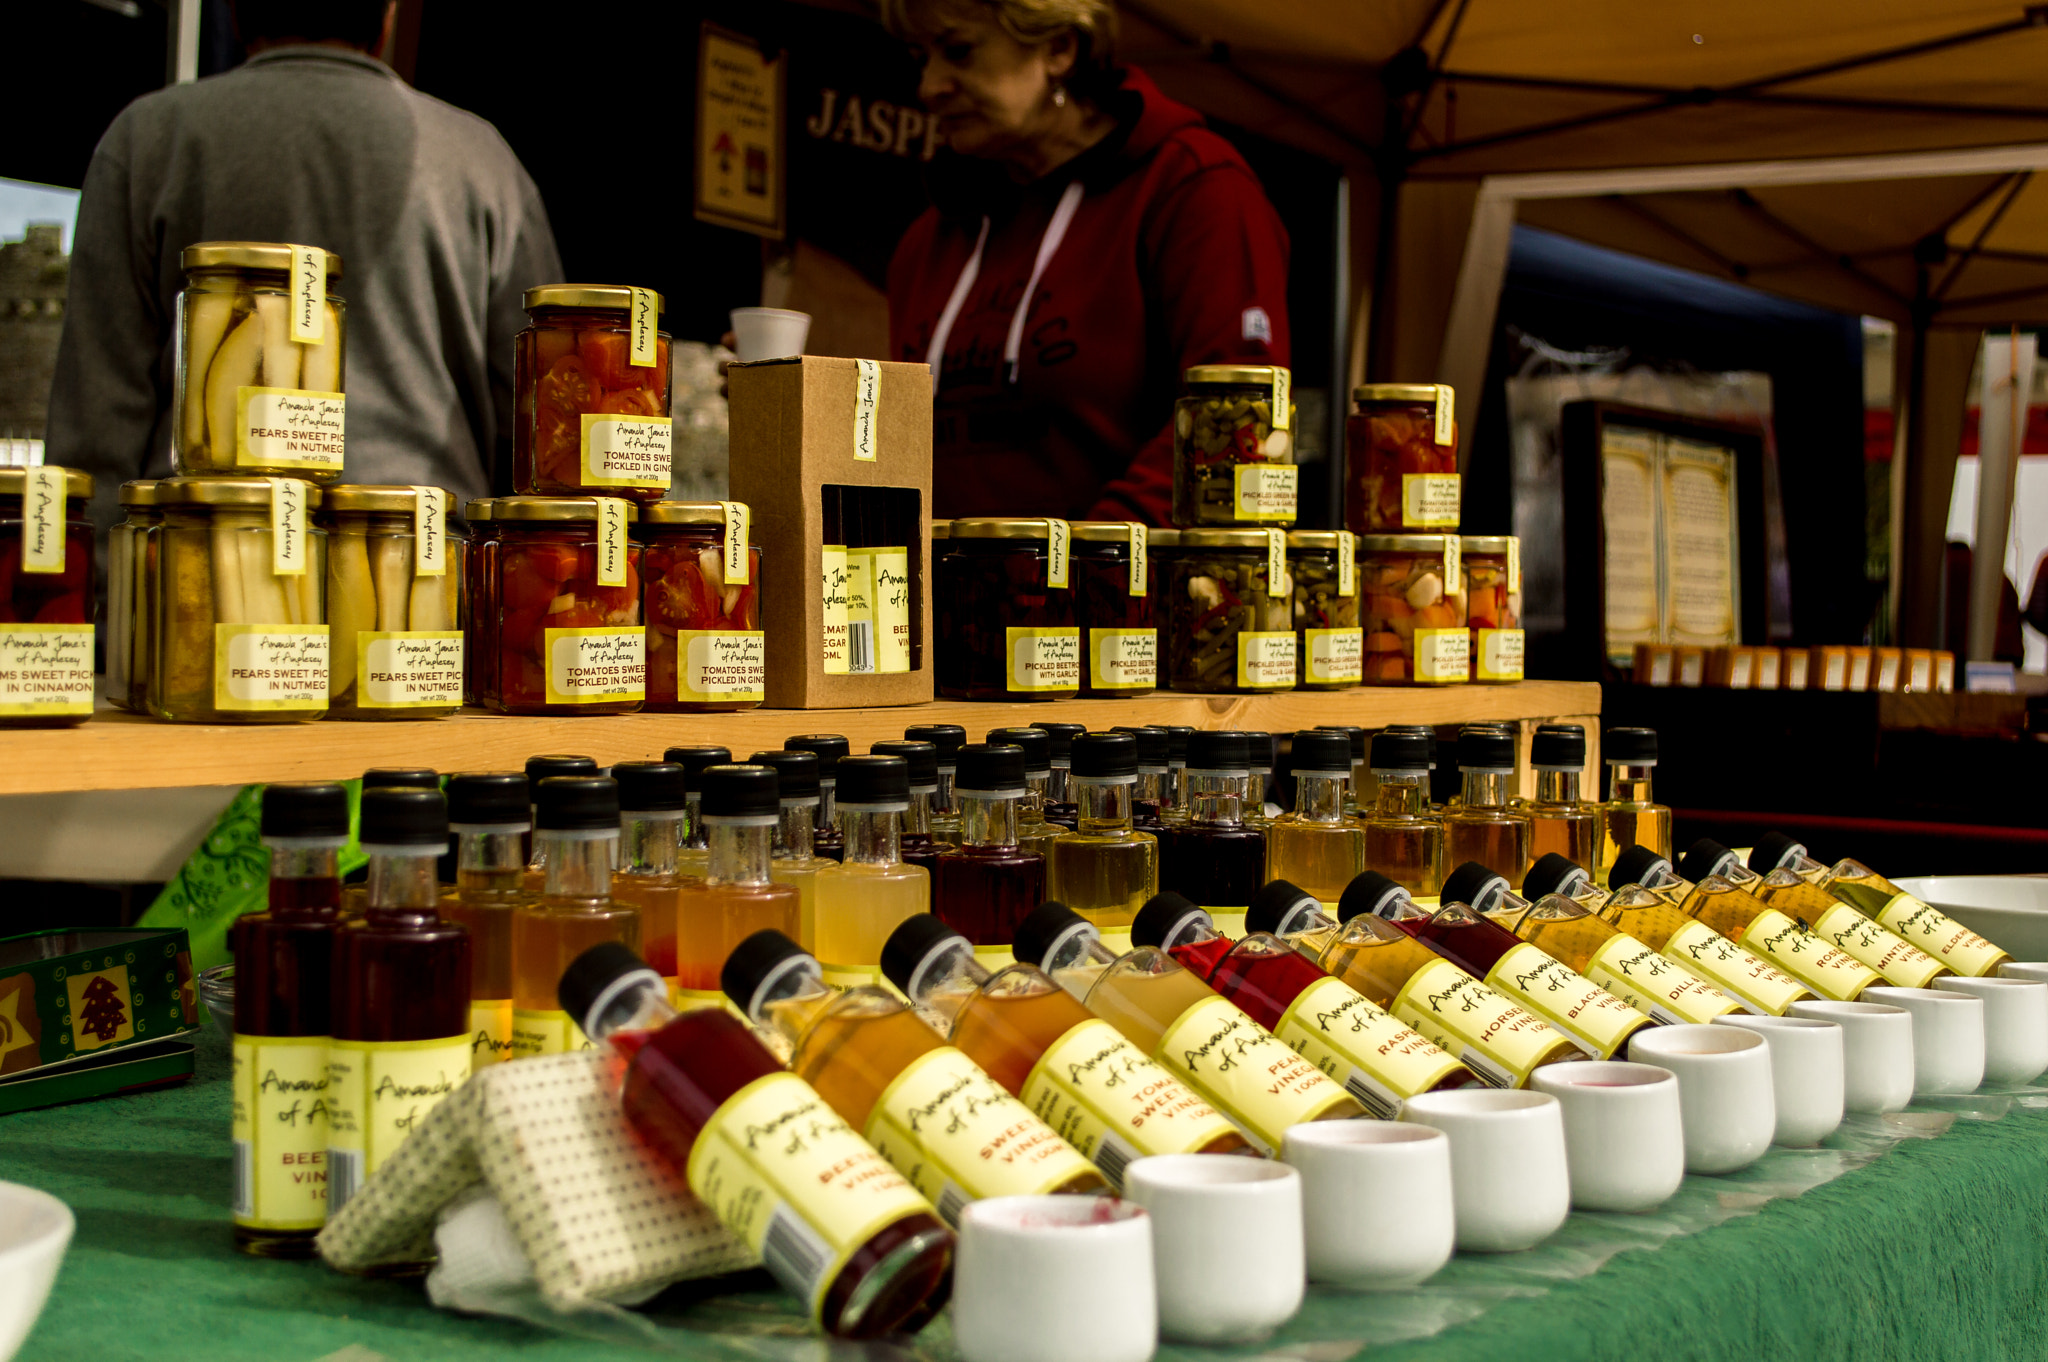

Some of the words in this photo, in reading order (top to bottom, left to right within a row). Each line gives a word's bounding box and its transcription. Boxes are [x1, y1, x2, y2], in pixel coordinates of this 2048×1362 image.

[863, 375, 873, 407] Jane's
[278, 397, 314, 411] Amanda
[319, 401, 344, 415] Jane's
[288, 415, 299, 428] of
[300, 413, 340, 429] Anglesey
[251, 428, 289, 439] PEARS
[291, 430, 327, 441] SWEET
[616, 422, 645, 437] Amanda
[648, 424, 669, 440] Jane's
[859, 412, 869, 453] Amanda
[286, 441, 297, 450] IN
[300, 442, 343, 453] NUTMEG
[624, 439, 633, 449] of
[633, 439, 666, 451] Anglesey
[604, 451, 651, 462] TOMATOES
[603, 462, 641, 471] PICKLED
[642, 463, 652, 471] IN
[890, 589, 901, 608] of
[3, 634, 48, 650] Amanda
[54, 633, 87, 652] Jane's
[260, 635, 296, 650] Amanda
[300, 636, 327, 652] Jane's
[397, 639, 434, 654] Amanda
[435, 640, 460, 656] Jane's
[580, 637, 612, 651] Amanda
[614, 635, 638, 653] Jane's
[714, 637, 739, 650] Amanda
[742, 637, 763, 655] Jane's
[16, 652, 26, 664] of
[32, 652, 80, 667] Anglesey
[270, 651, 281, 664] of
[282, 651, 323, 666] Anglesey
[406, 655, 417, 666] of
[418, 654, 456, 669] Anglesey
[590, 651, 599, 663] of
[599, 650, 634, 664] Anglesey
[721, 653, 730, 662] of
[730, 652, 759, 665] Anglesey
[1043, 651, 1050, 660] of
[1051, 649, 1073, 661] Anglesey
[567, 666, 620, 677] TOMATOES
[702, 666, 746, 675] TOMATOES
[1025, 662, 1055, 670] PICKLED
[1110, 660, 1137, 668] PICKLED
[1138, 668, 1155, 676] GARLIC
[21, 671, 65, 680] SWEET
[232, 669, 271, 679] PEARS
[273, 669, 309, 679] SWEET
[371, 672, 408, 681] PEARS
[410, 672, 443, 681] SWEET
[567, 677, 609, 687] PICKLED
[611, 676, 620, 685] IN
[701, 676, 737, 685] PICKLED
[737, 676, 746, 684] IN
[1039, 670, 1056, 678] WITH
[1056, 670, 1078, 678] GARLIC
[7, 683, 20, 692] IN
[24, 683, 93, 692] CINNAMON
[269, 681, 280, 690] IN
[283, 681, 326, 690] NUTMEG
[406, 683, 416, 692] IN
[419, 682, 460, 691] NUTMEG
[1923, 920, 1937, 935] of
[1791, 935, 1807, 953] of
[1860, 930, 1875, 947] of
[1717, 944, 1733, 961] of
[1649, 960, 1664, 976] of
[1548, 973, 1565, 992] of
[1669, 980, 1694, 1001] DILL
[1461, 993, 1480, 1013] of
[1351, 1009, 1370, 1032] of
[1184, 1017, 1240, 1071] Amanda
[1218, 1047, 1239, 1072] of
[1105, 1063, 1126, 1087] of
[908, 1071, 972, 1132] Amanda
[1131, 1086, 1182, 1129] SWEET
[278, 1100, 303, 1127] of
[395, 1105, 418, 1132] of
[946, 1107, 968, 1134] of
[785, 1128, 809, 1155] of
